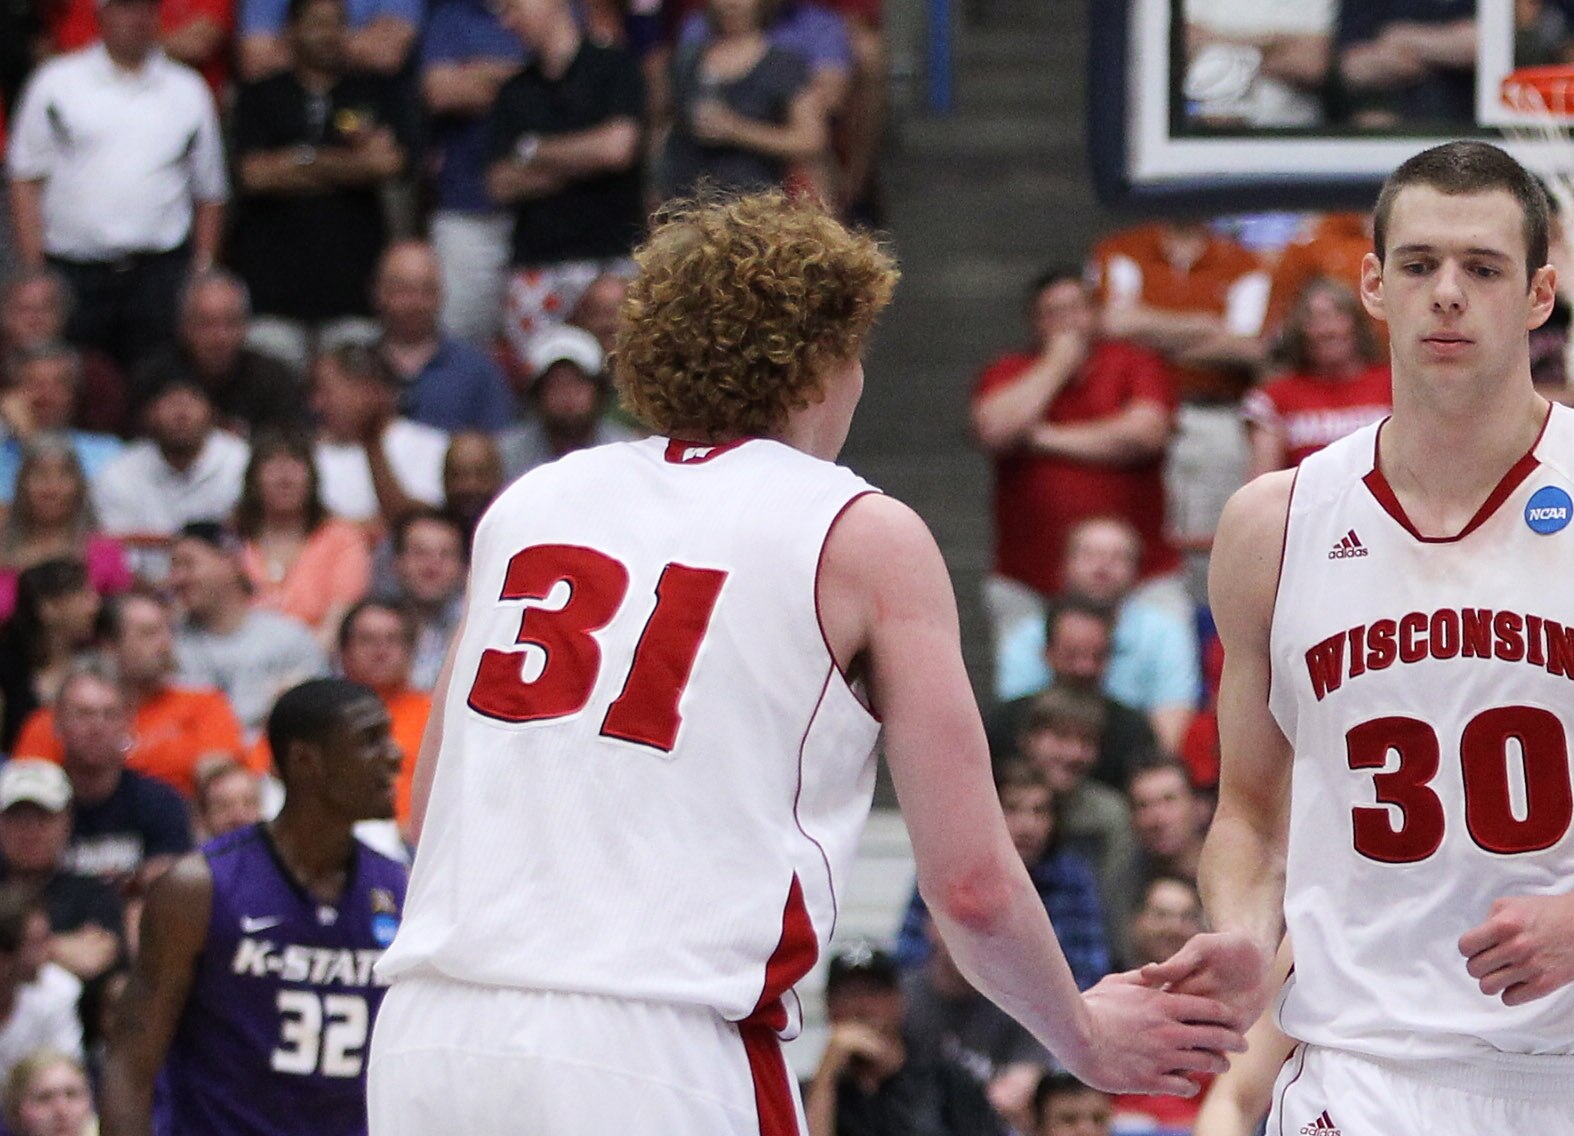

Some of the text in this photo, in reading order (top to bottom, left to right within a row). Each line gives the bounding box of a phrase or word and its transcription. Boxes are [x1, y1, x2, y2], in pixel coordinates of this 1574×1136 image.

[1328, 547, 1369, 560] adidas
[1529, 507, 1567, 521] NCAA
[467, 543, 729, 753] 31
[1345, 705, 1574, 864] 30
[270, 989, 369, 1079] 32
